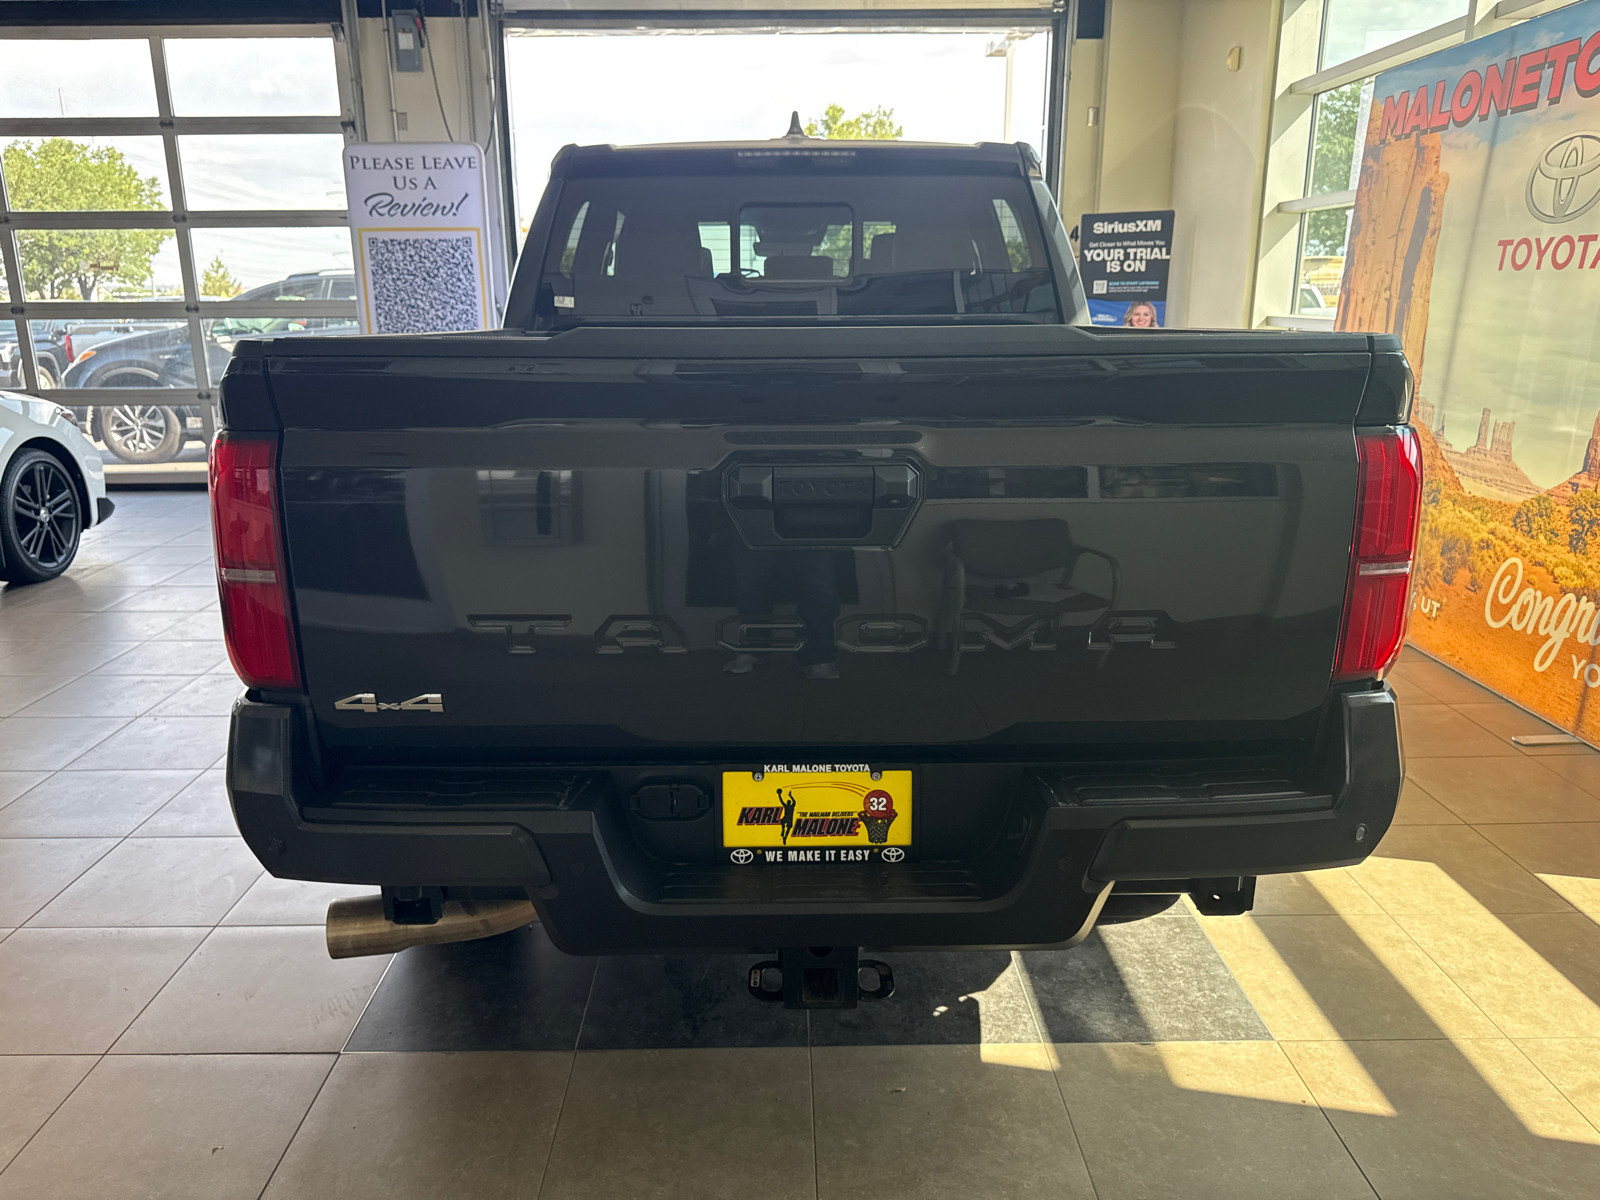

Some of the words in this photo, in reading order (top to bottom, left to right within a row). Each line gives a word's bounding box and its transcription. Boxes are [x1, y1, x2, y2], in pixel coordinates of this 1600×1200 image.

[350, 155, 415, 170] PLEASE
[421, 155, 477, 170] LEAVE
[424, 176, 438, 190] A
[363, 192, 469, 217] Review!
[1070, 225, 1079, 242] 4
[1092, 219, 1162, 235] SiriusXM
[1083, 249, 1124, 262] YOUR
[1127, 247, 1171, 260] TRIAL
[1106, 261, 1121, 273] IS
[1123, 260, 1146, 272] ON
[779, 480, 868, 496] TOYOTA
[1421, 596, 1441, 618] UT
[466, 611, 1177, 654] TACOMA
[763, 764, 789, 773] KARL
[792, 764, 832, 773] MALONE
[834, 763, 870, 772] TOYOTA
[868, 797, 887, 811] 32
[737, 807, 784, 826] KARL
[791, 817, 861, 837] MALONE
[765, 851, 783, 862] WE
[787, 850, 821, 862] MAKE
[825, 850, 836, 861] IT
[840, 850, 870, 861] EASY
